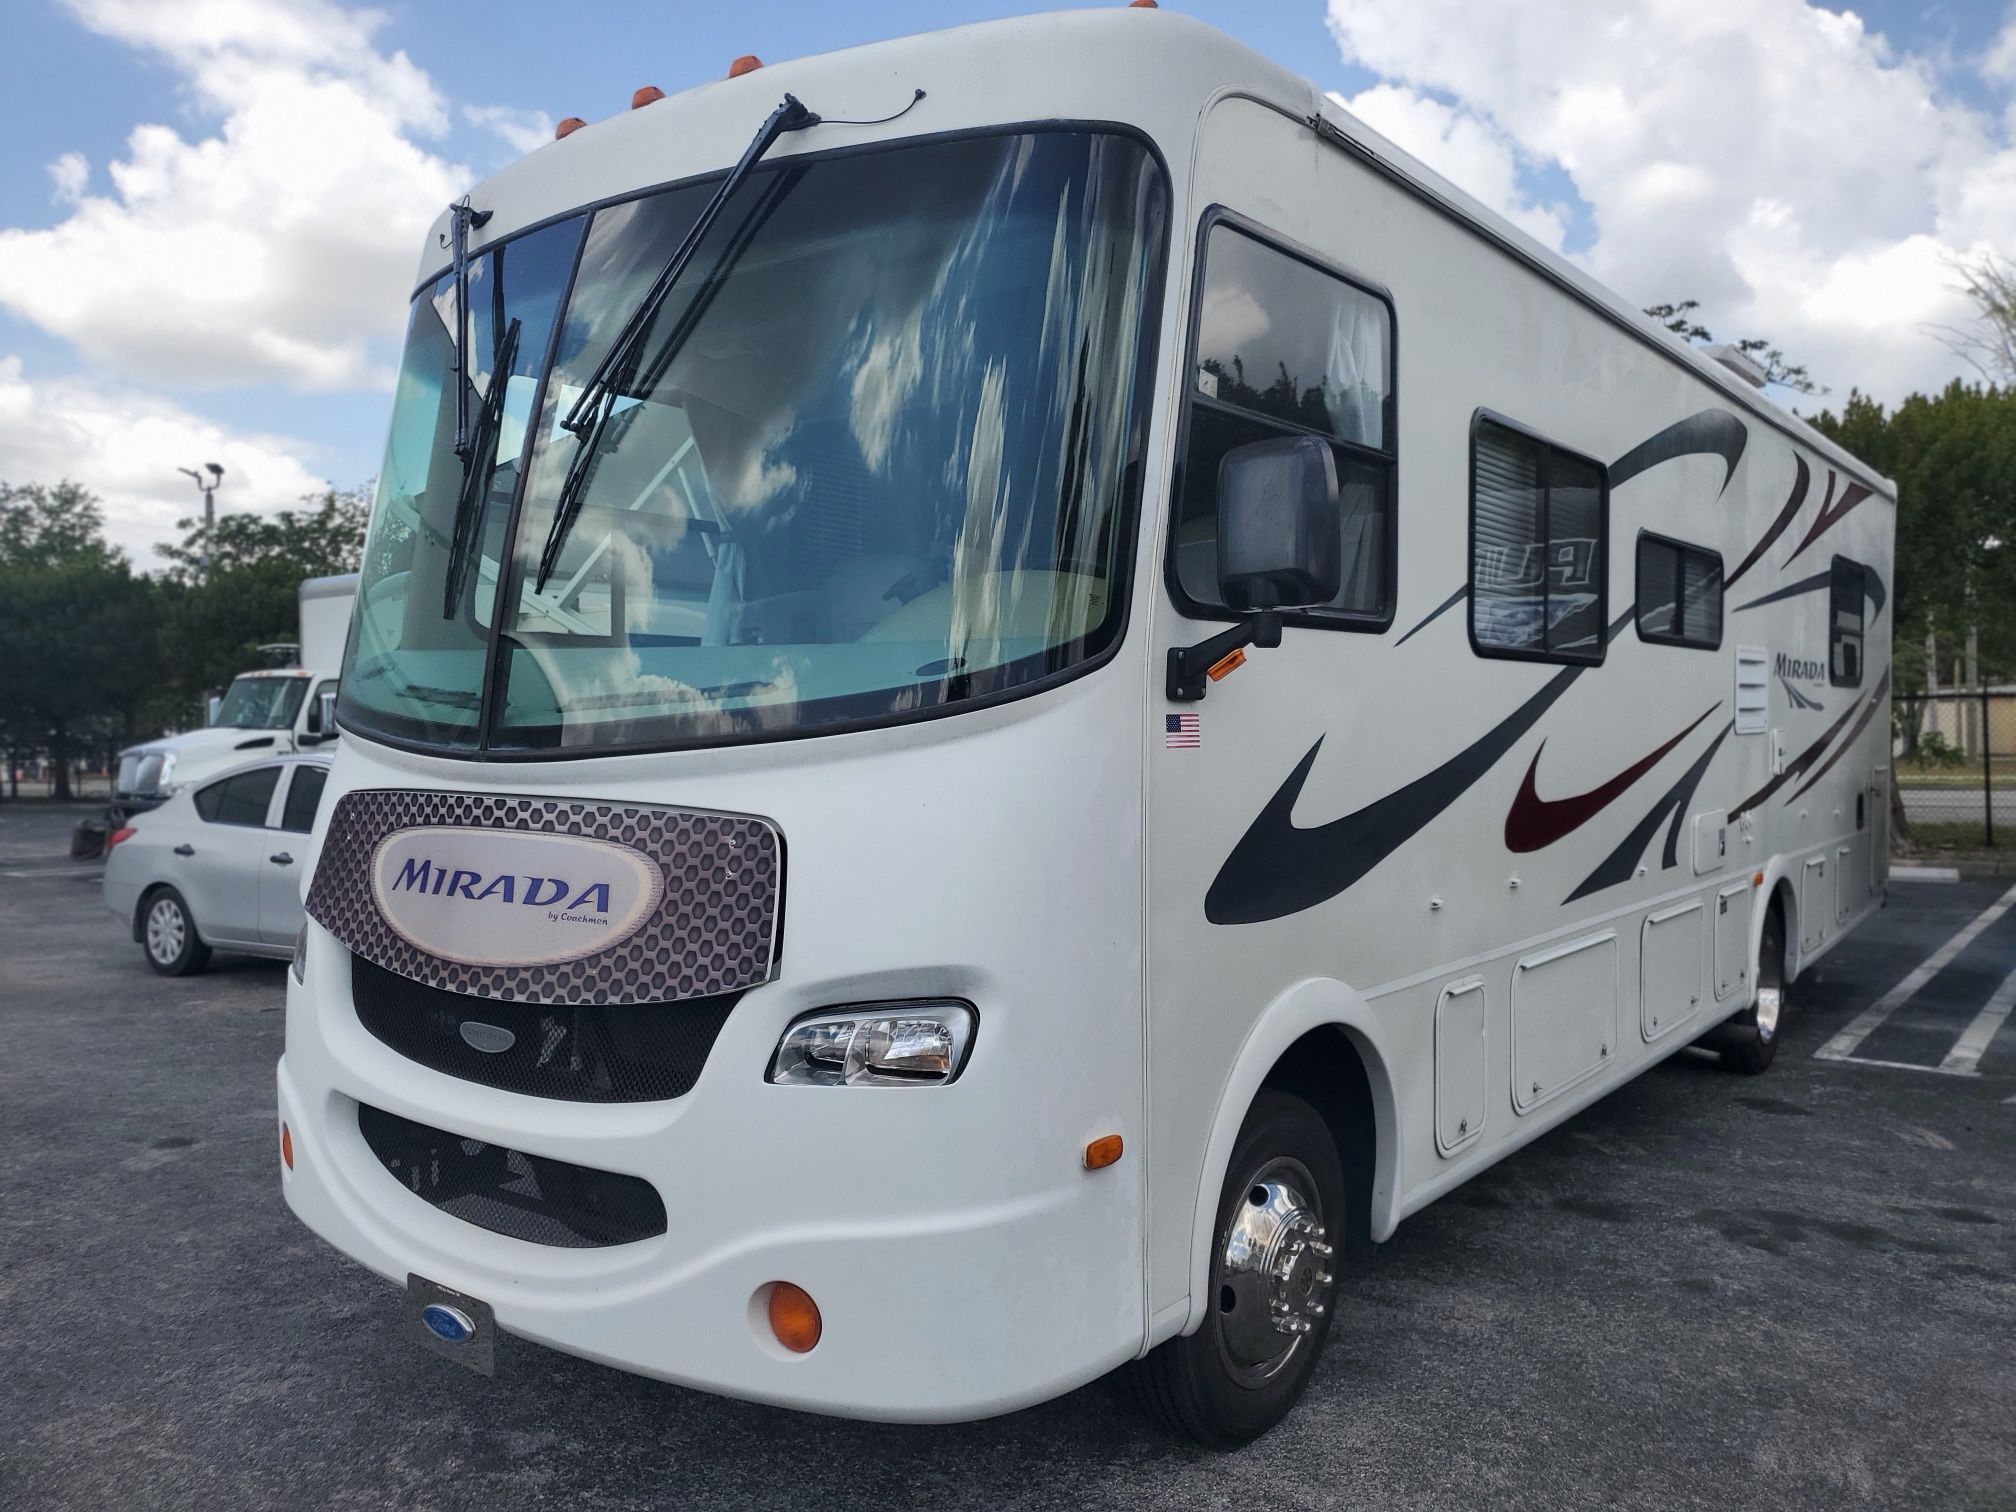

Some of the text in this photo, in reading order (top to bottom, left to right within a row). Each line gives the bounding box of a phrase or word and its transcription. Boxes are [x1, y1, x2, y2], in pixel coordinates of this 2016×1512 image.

[1773, 652, 1825, 680] MIRADA
[392, 858, 609, 913] MIRADA
[548, 911, 608, 925] by Coachmen
